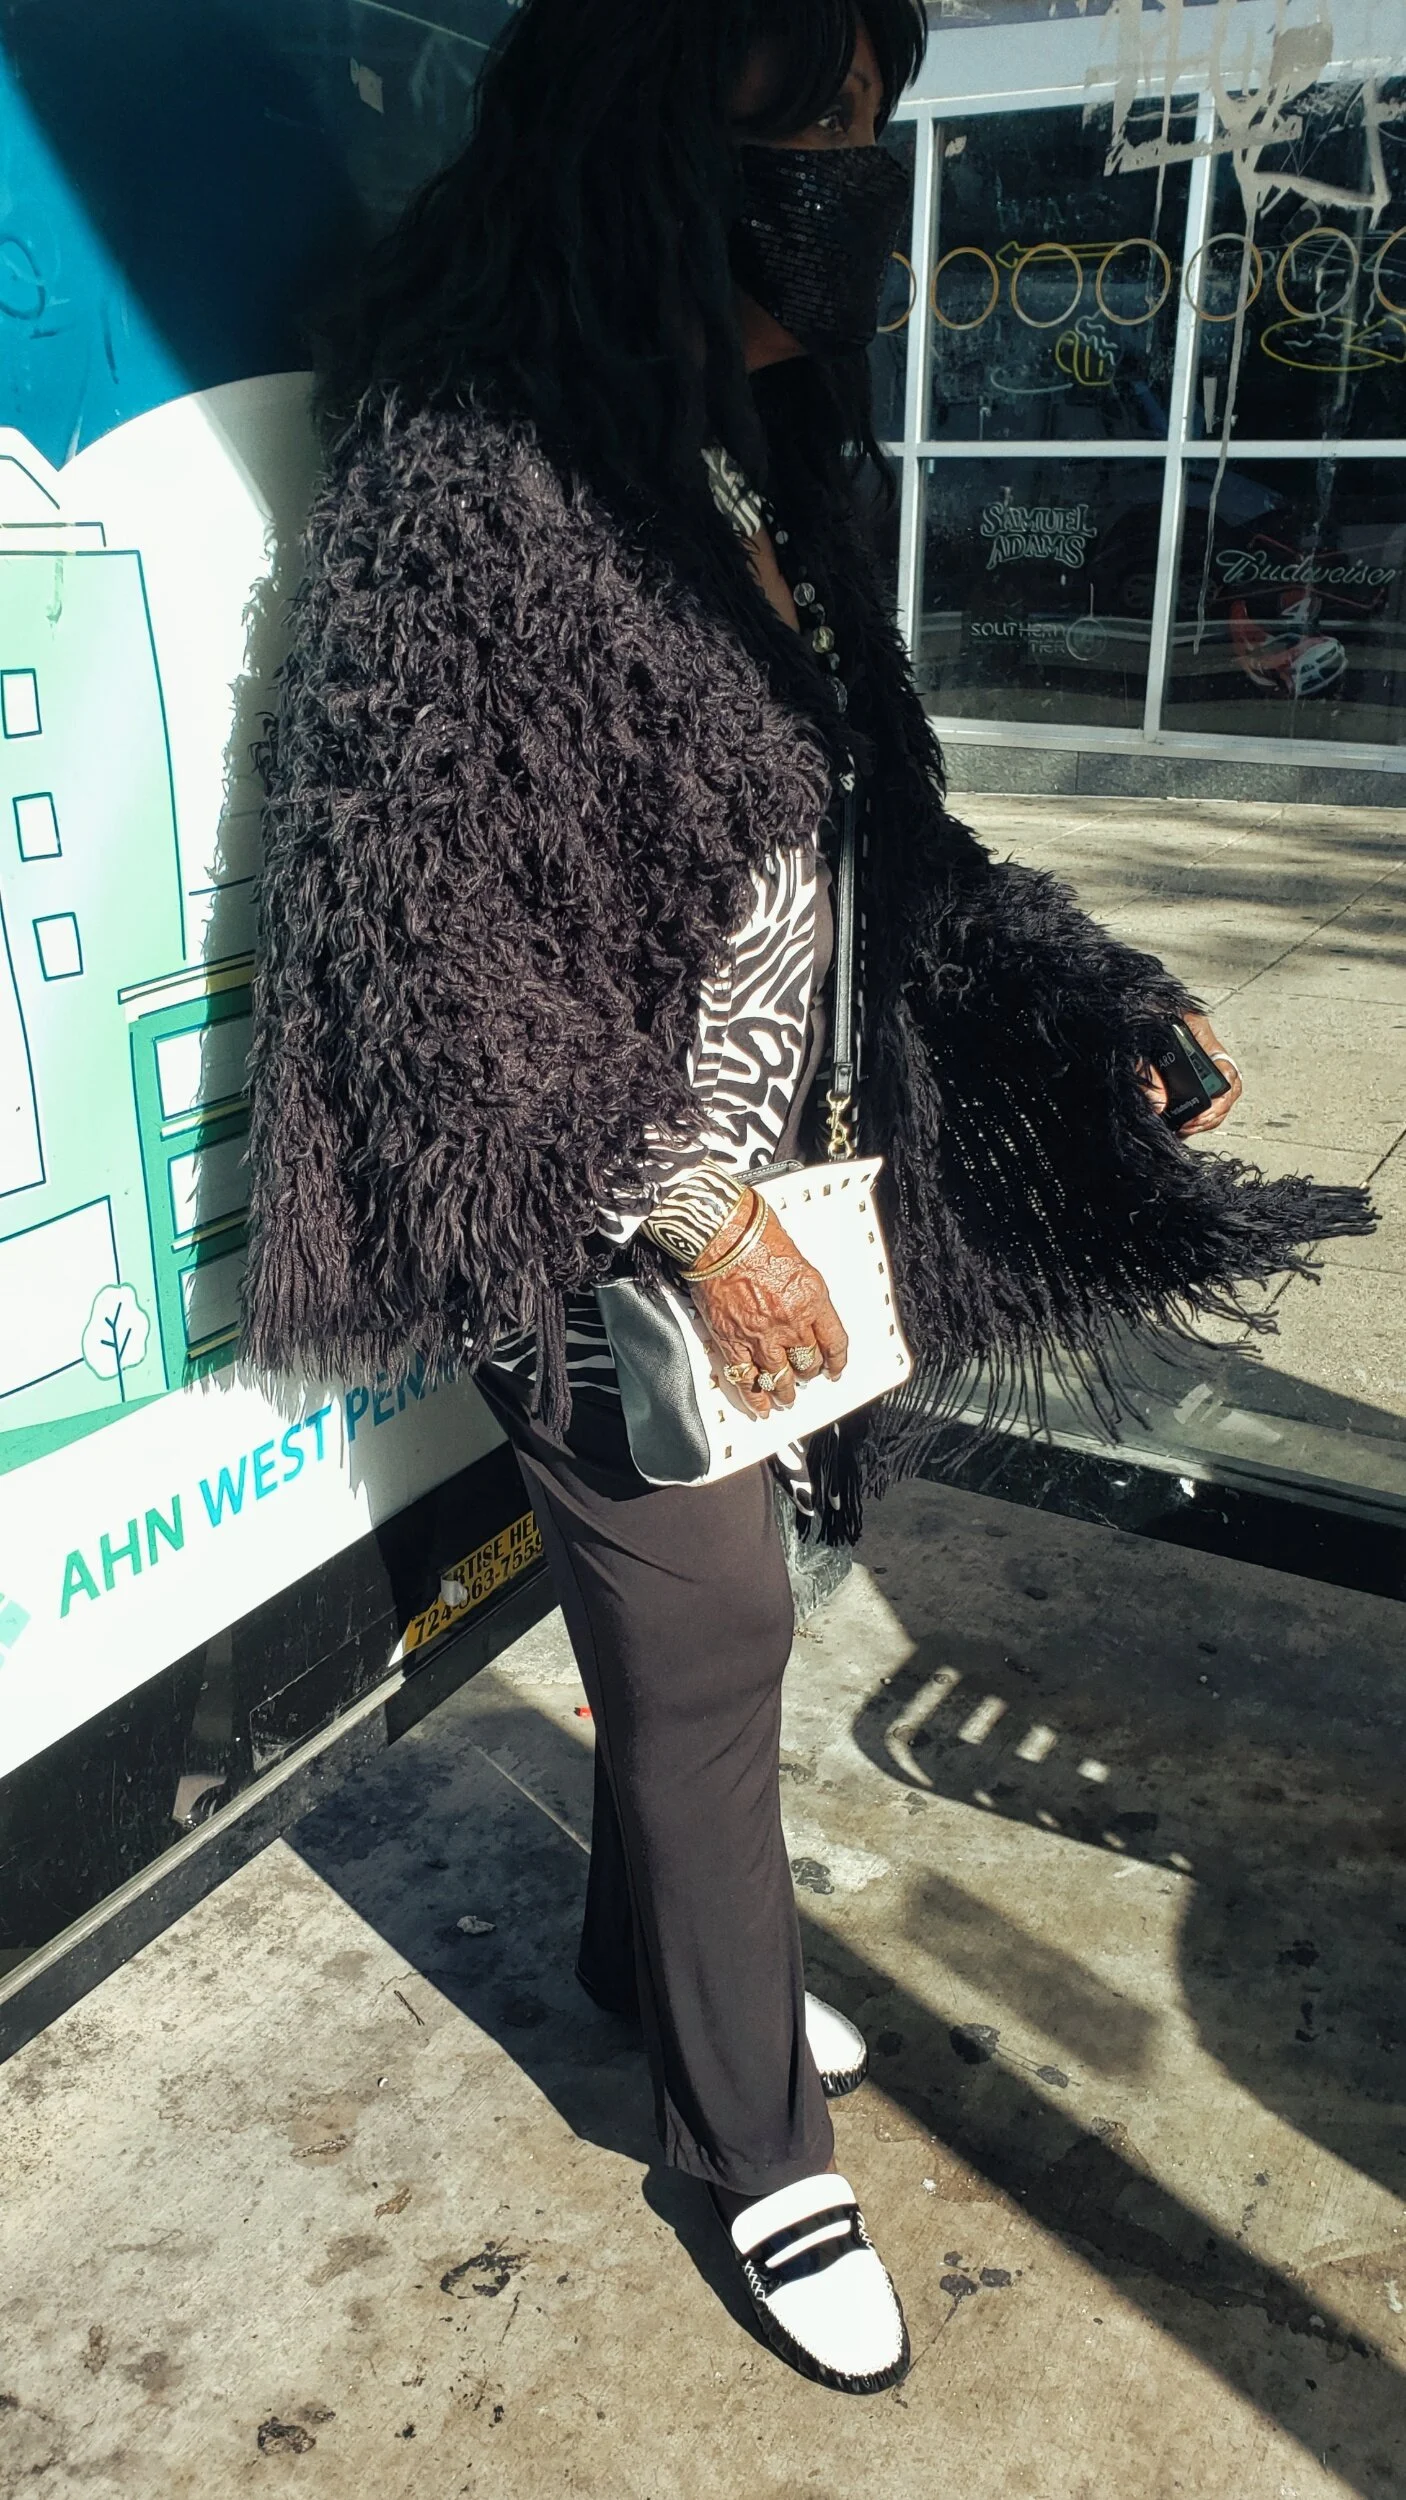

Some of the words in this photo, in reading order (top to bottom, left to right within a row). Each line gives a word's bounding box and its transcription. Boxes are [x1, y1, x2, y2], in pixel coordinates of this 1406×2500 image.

[980, 502, 1097, 538] SAMUEL
[986, 533, 1085, 570] ADAMS
[1214, 549, 1396, 586] Budweiser
[970, 622, 1067, 638] SOUTHERN
[60, 1494, 185, 1619] AHN
[199, 1403, 332, 1528] WEST
[444, 1535, 504, 1586] RTISE
[509, 1514, 538, 1550] HE
